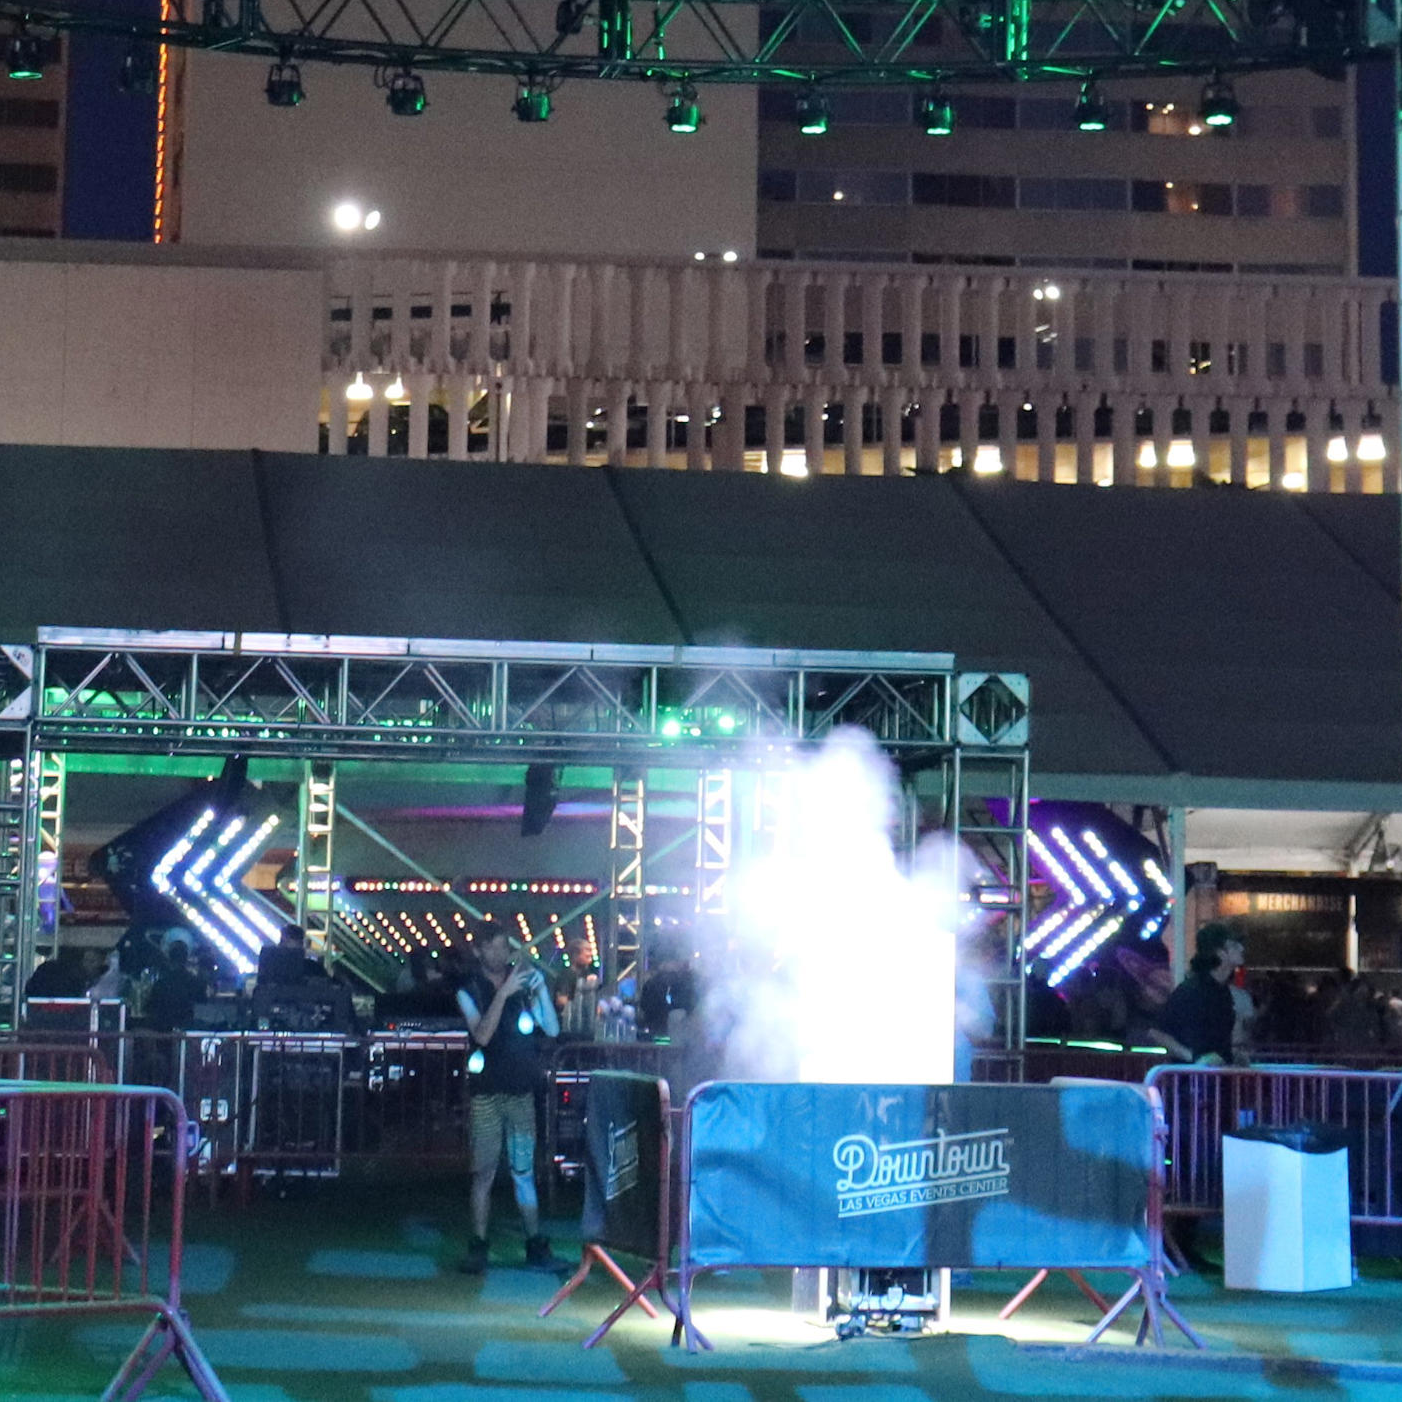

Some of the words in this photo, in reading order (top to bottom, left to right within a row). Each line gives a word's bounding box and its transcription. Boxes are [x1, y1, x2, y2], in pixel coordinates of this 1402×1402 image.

[833, 1128, 1011, 1192] Downtown
[838, 1198, 863, 1212] LAS
[866, 1191, 907, 1208] VEGAS
[910, 1183, 957, 1202] EVENTS
[959, 1177, 1008, 1196] CENTER
